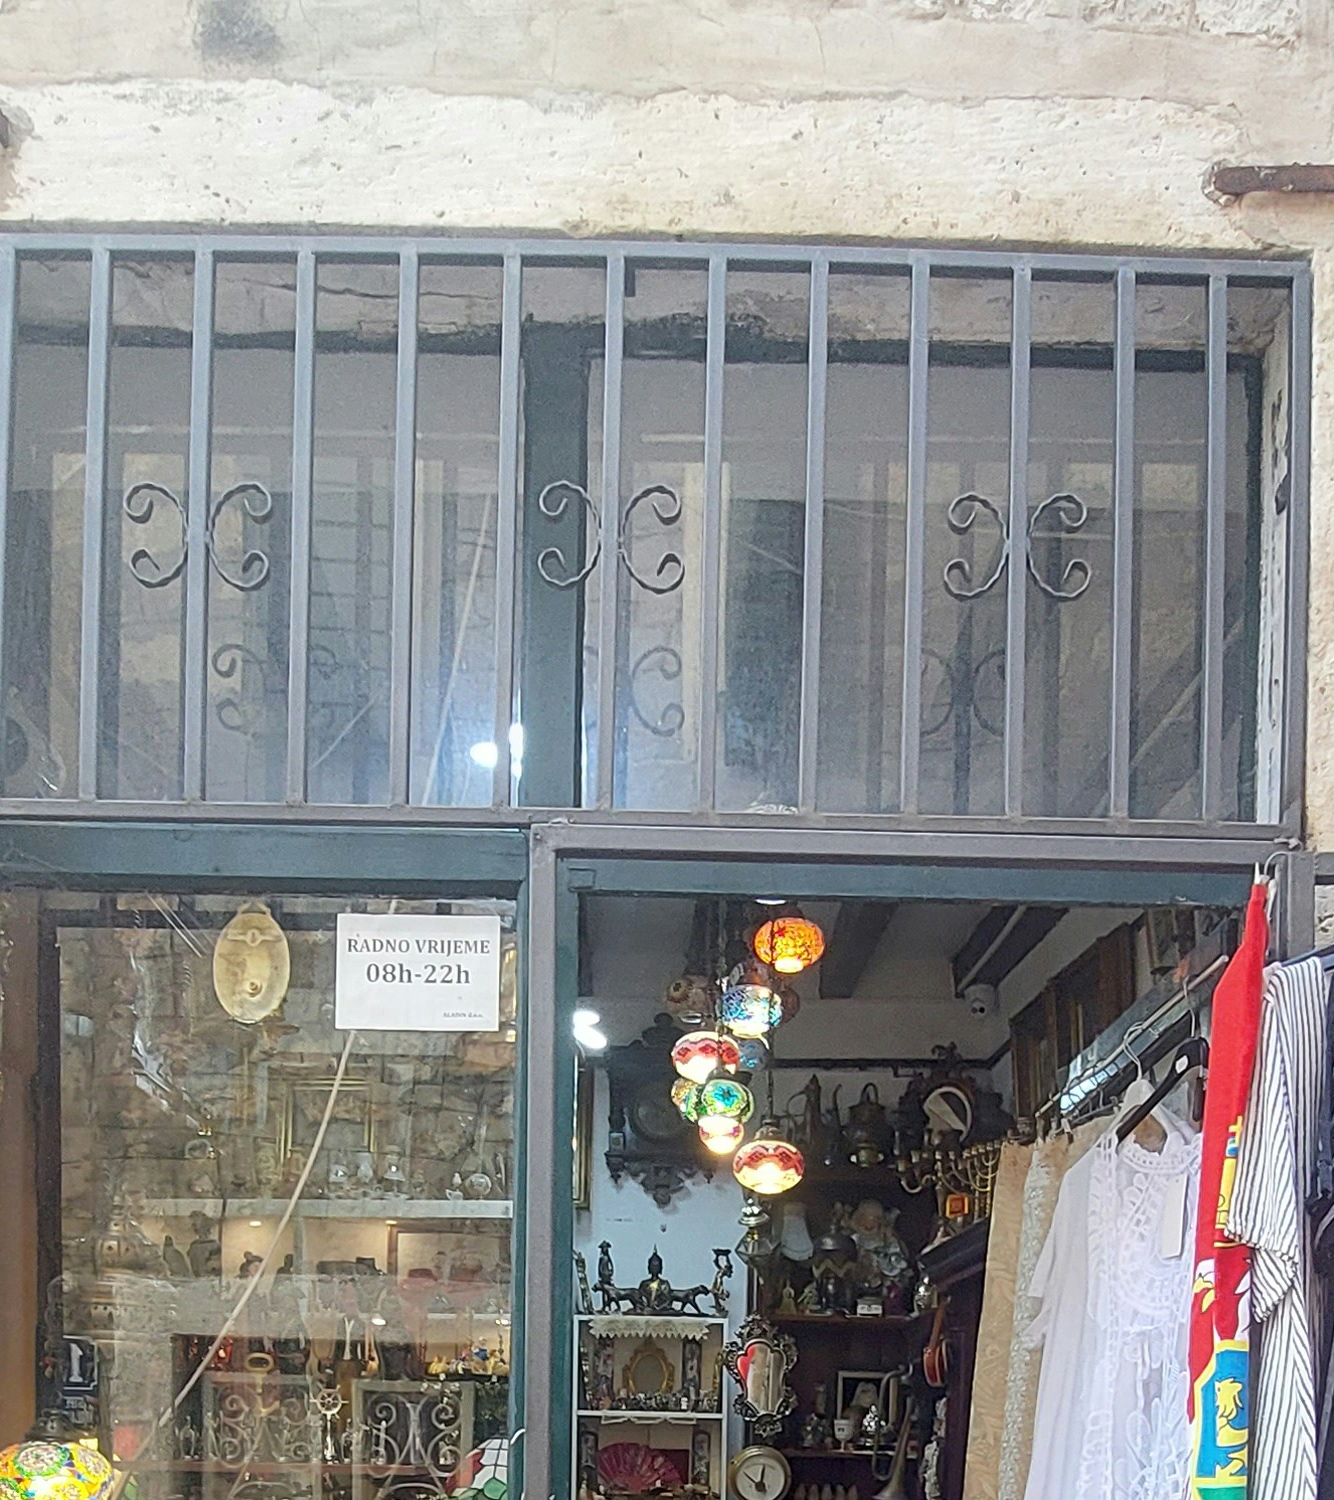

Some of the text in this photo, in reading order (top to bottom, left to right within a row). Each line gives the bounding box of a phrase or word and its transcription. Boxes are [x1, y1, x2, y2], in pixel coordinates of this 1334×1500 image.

[347, 938, 491, 956] RADNO VRIJEME
[366, 963, 470, 984] 08h-22h
